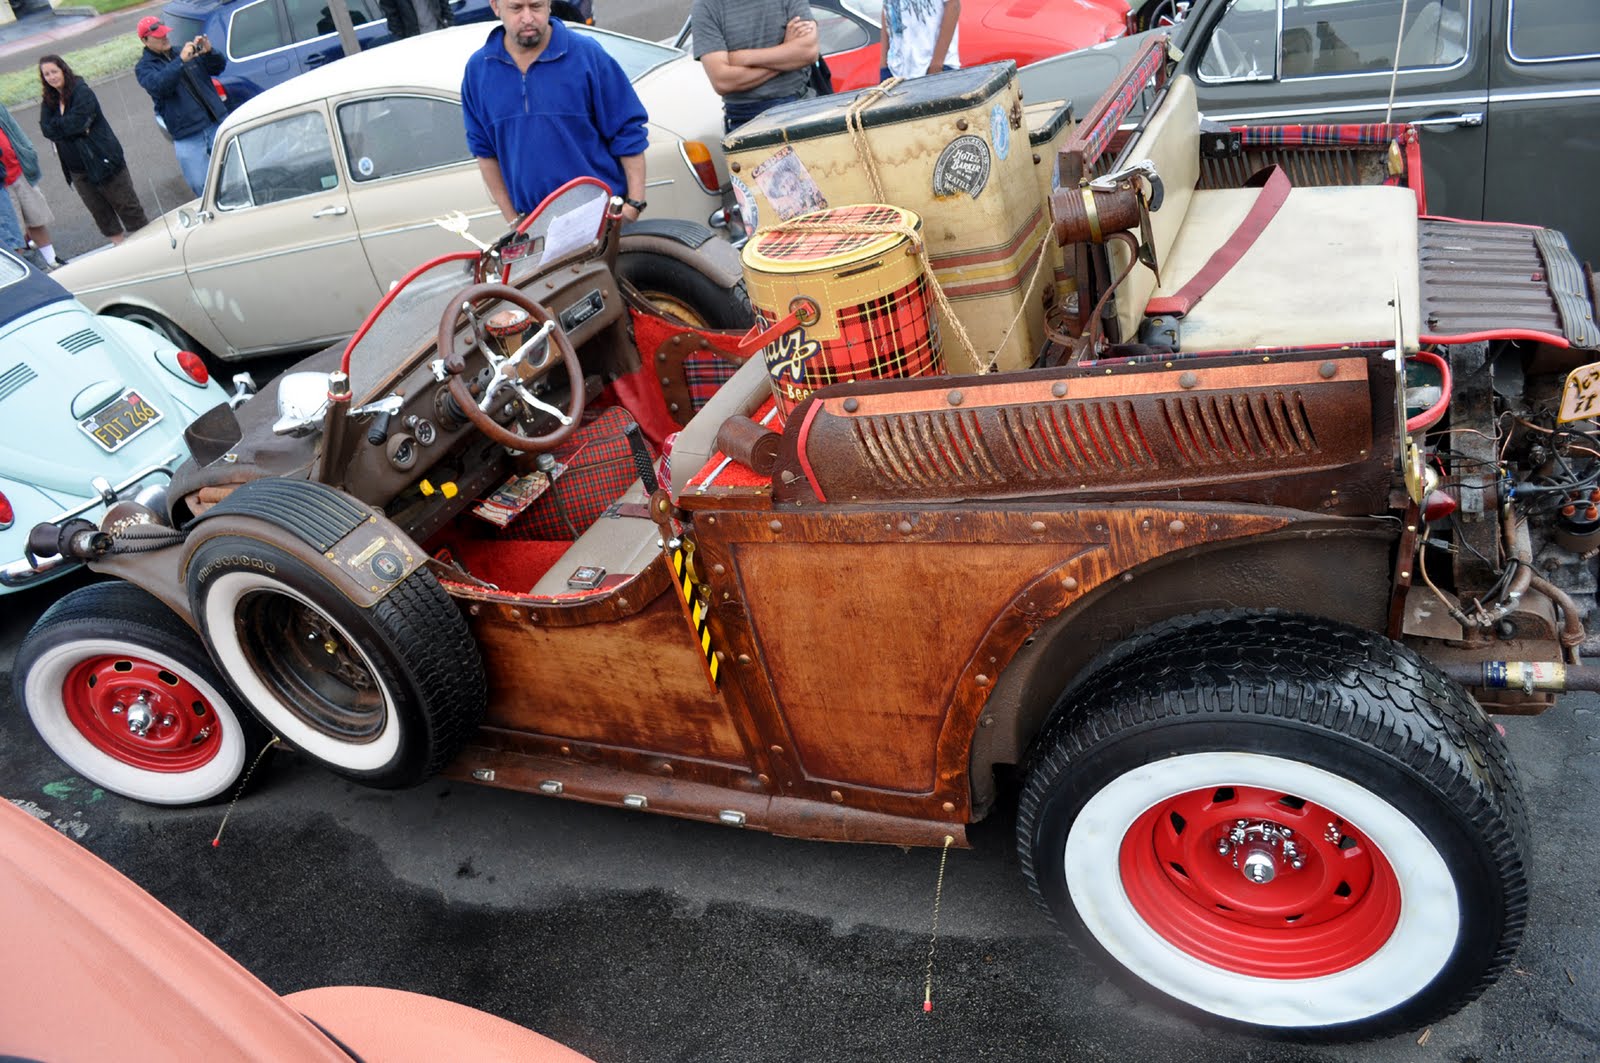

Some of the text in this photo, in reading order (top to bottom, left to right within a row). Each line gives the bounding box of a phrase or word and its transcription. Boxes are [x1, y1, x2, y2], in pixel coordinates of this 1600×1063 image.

[951, 158, 981, 173] BARKER
[952, 150, 980, 163] HOTEL
[945, 172, 971, 190] SEATTLE
[786, 383, 814, 401] Bee
[94, 417, 130, 446] FDT
[124, 401, 155, 427] 266
